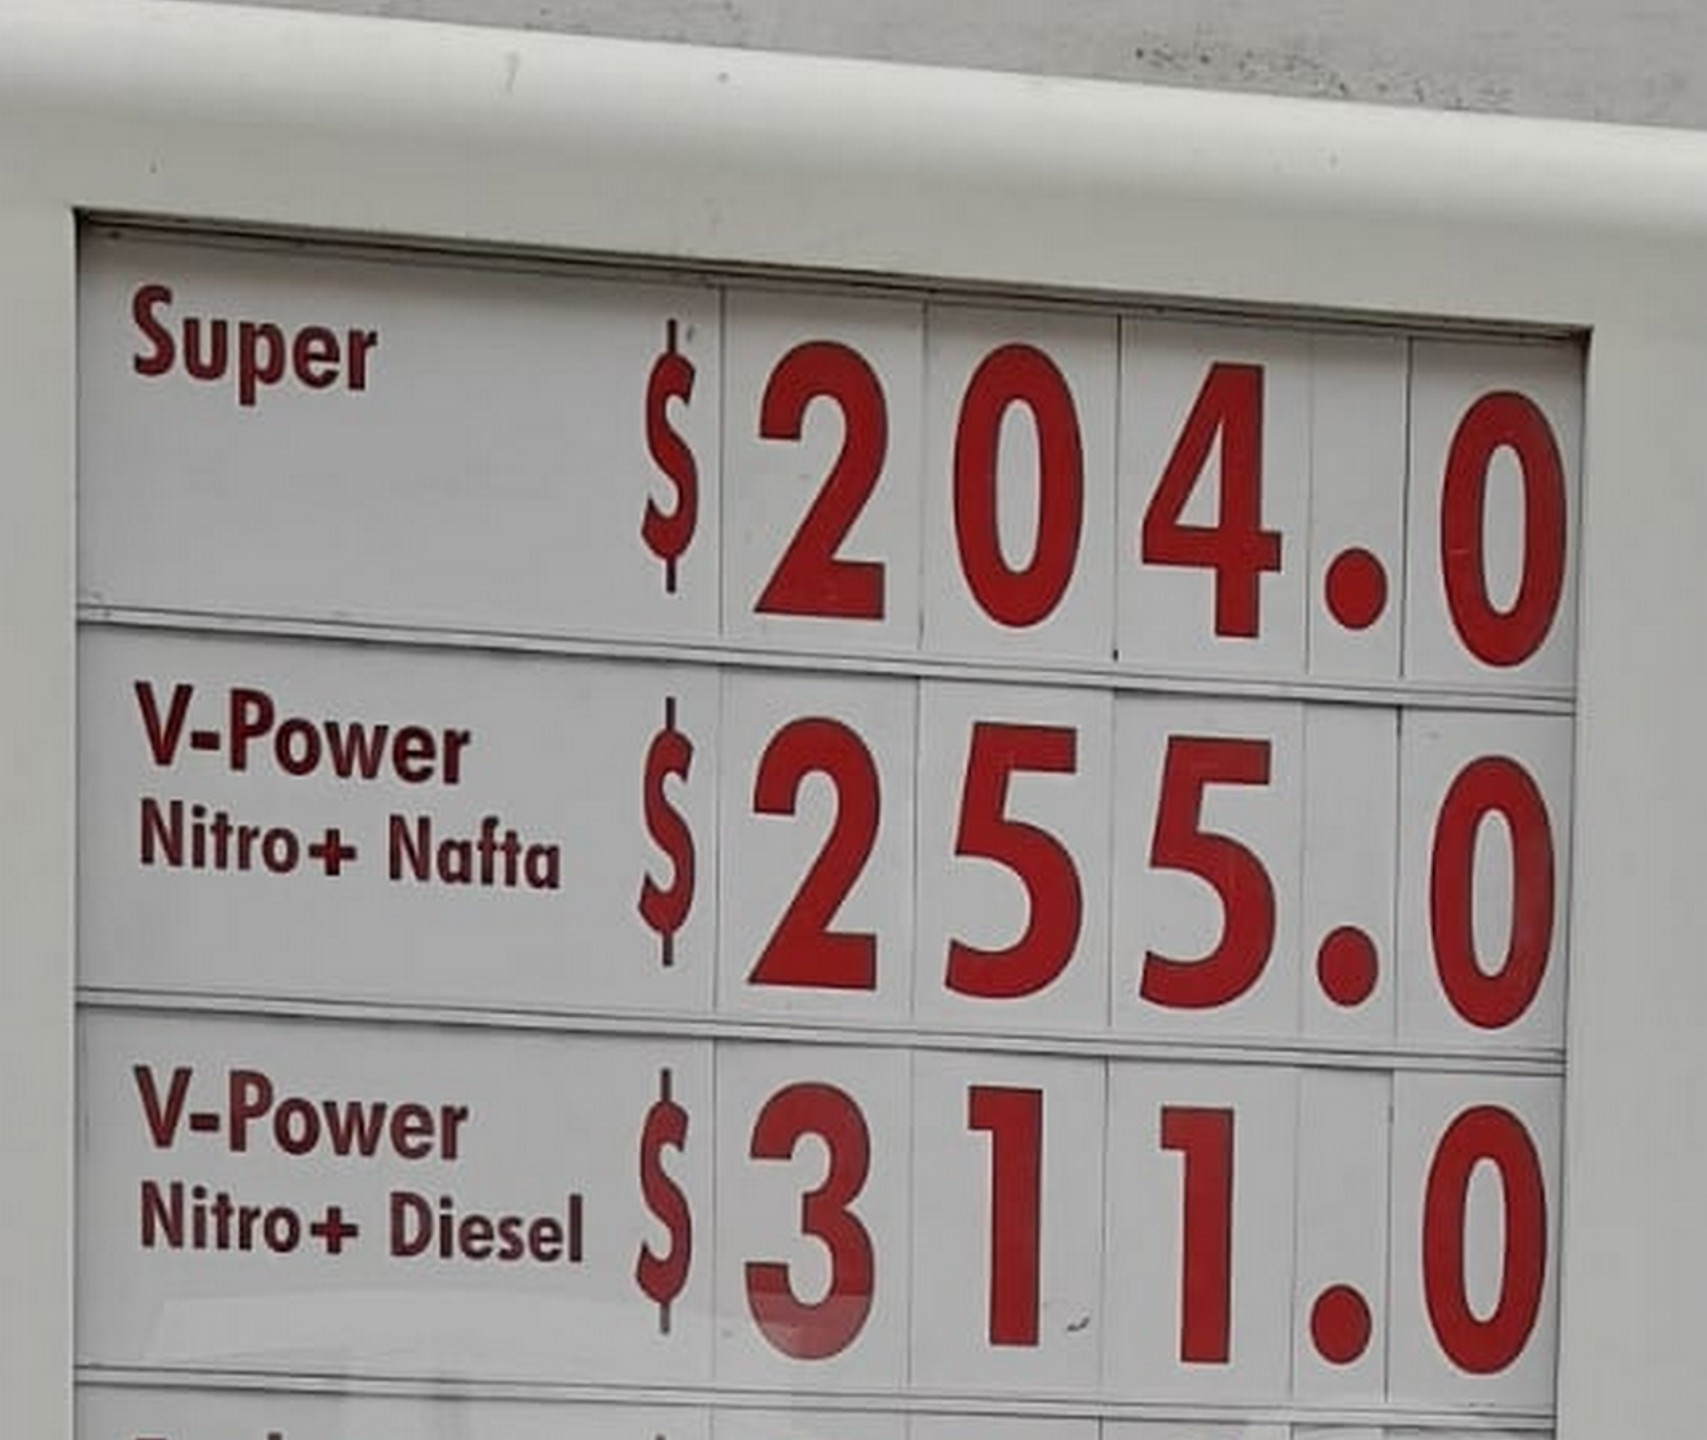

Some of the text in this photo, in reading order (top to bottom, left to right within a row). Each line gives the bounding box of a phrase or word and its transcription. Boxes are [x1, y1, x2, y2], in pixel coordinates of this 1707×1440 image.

[132, 285, 378, 406] Super
[134, 681, 471, 785] V-Power
[140, 798, 562, 889] Nitro+ Nafta
[134, 1065, 468, 1161] V-Power
[140, 1180, 584, 1264] Nitro+ Diesel
